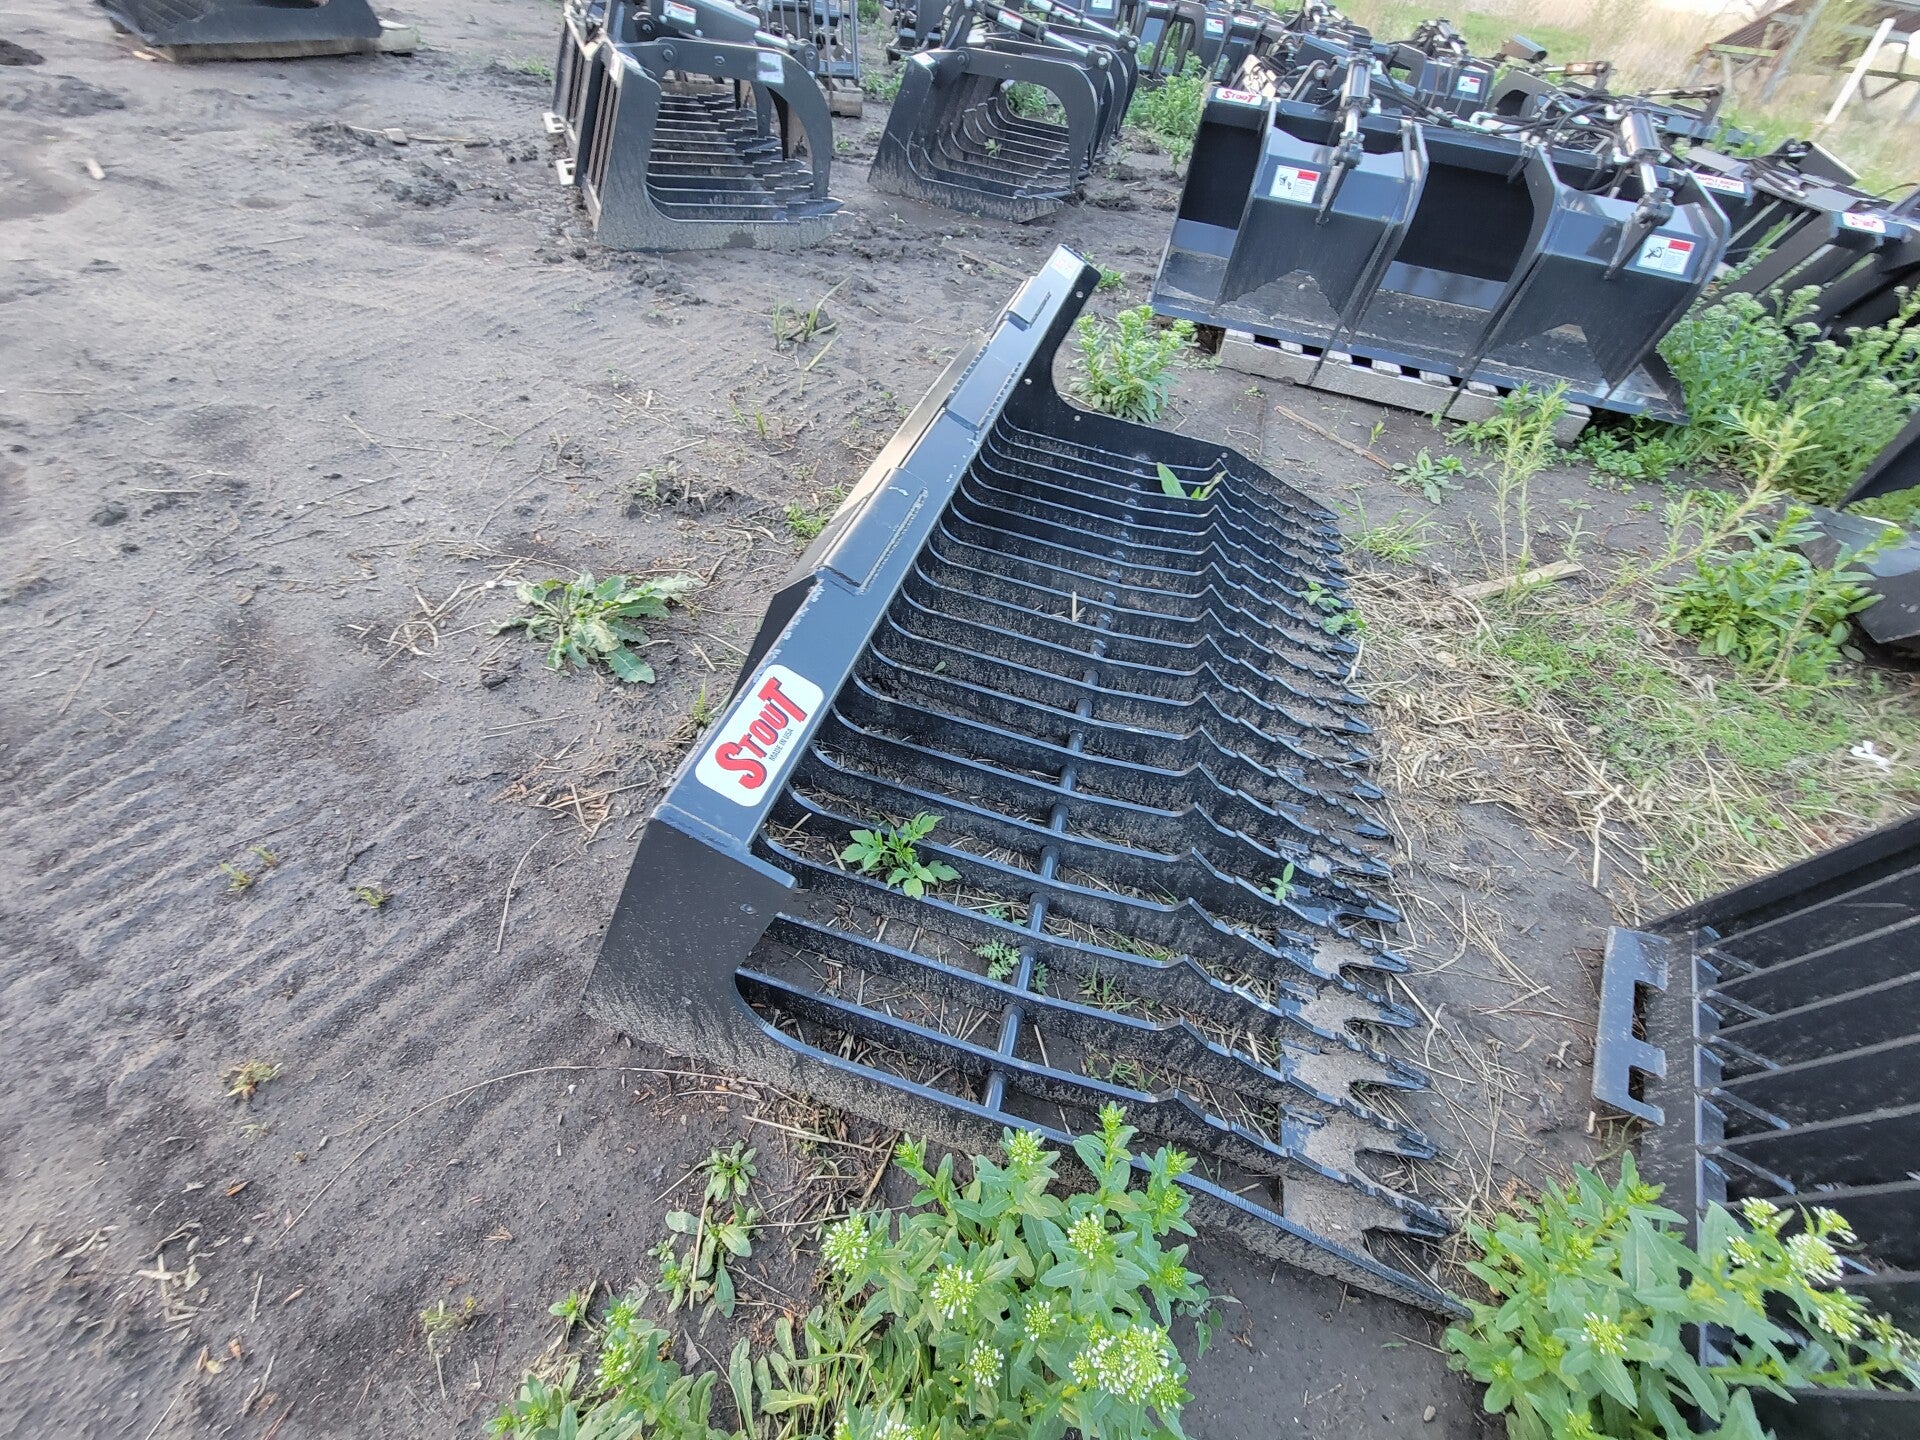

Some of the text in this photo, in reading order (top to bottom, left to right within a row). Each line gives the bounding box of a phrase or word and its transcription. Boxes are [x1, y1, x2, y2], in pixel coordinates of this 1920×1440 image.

[715, 677, 808, 790] STOUT
[769, 744, 783, 762] MADE
[782, 728, 794, 740] USA
